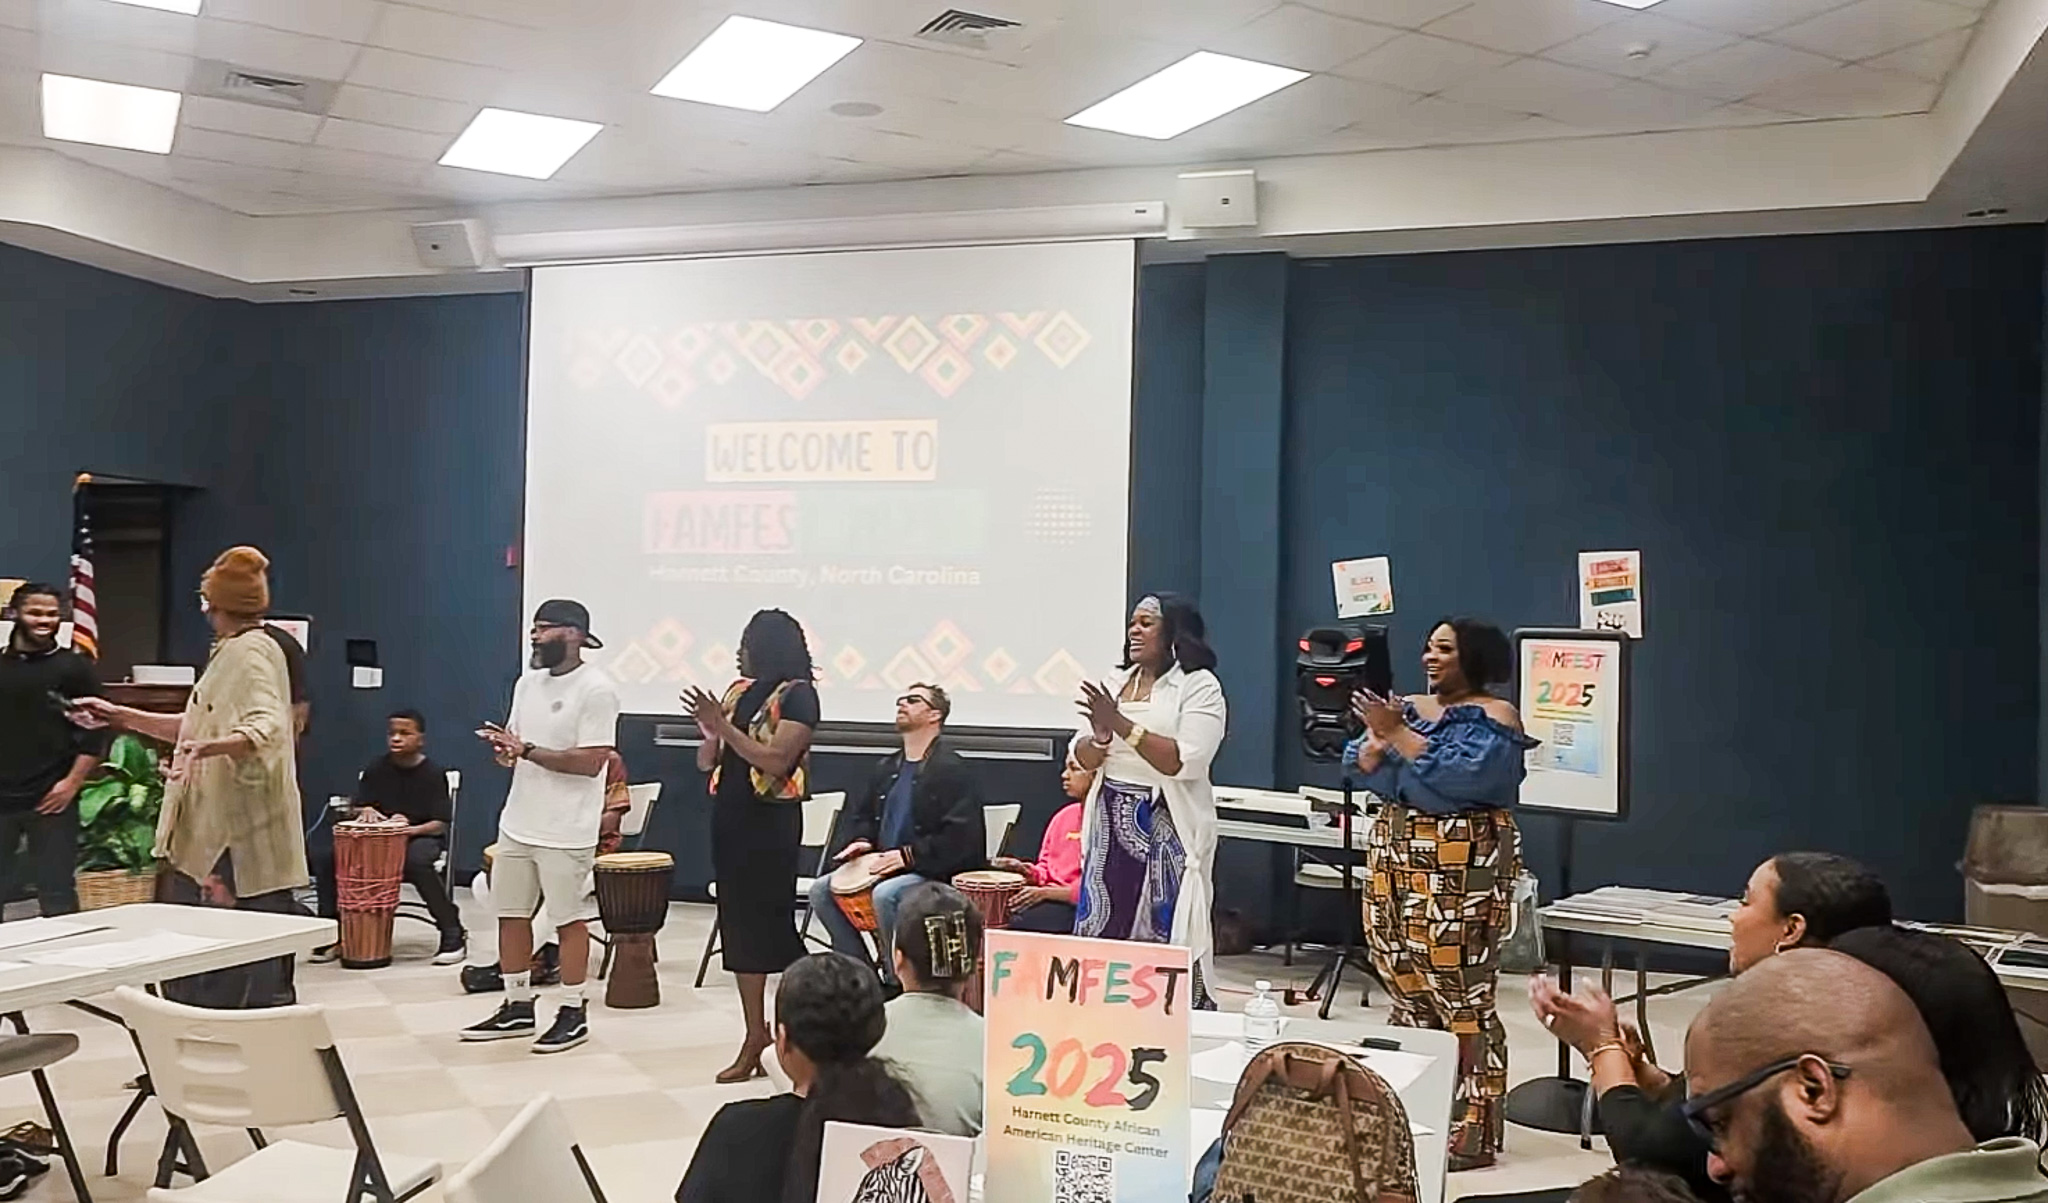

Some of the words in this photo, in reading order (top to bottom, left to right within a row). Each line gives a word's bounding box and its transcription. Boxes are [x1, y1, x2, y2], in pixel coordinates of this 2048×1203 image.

[712, 431, 873, 473] WELCOME
[891, 430, 936, 472] TO
[820, 565, 883, 585] North
[889, 564, 982, 586] Carolina
[1536, 681, 1596, 707] 2025
[991, 950, 1189, 1015] FAMFEST
[1005, 1032, 1168, 1111] 2025
[1012, 1106, 1061, 1123] Harnett
[1063, 1112, 1110, 1132] County
[1113, 1119, 1161, 1138] African
[1003, 1124, 1064, 1143] American
[1066, 1133, 1122, 1154] Heritage
[1124, 1143, 1170, 1159] Center
